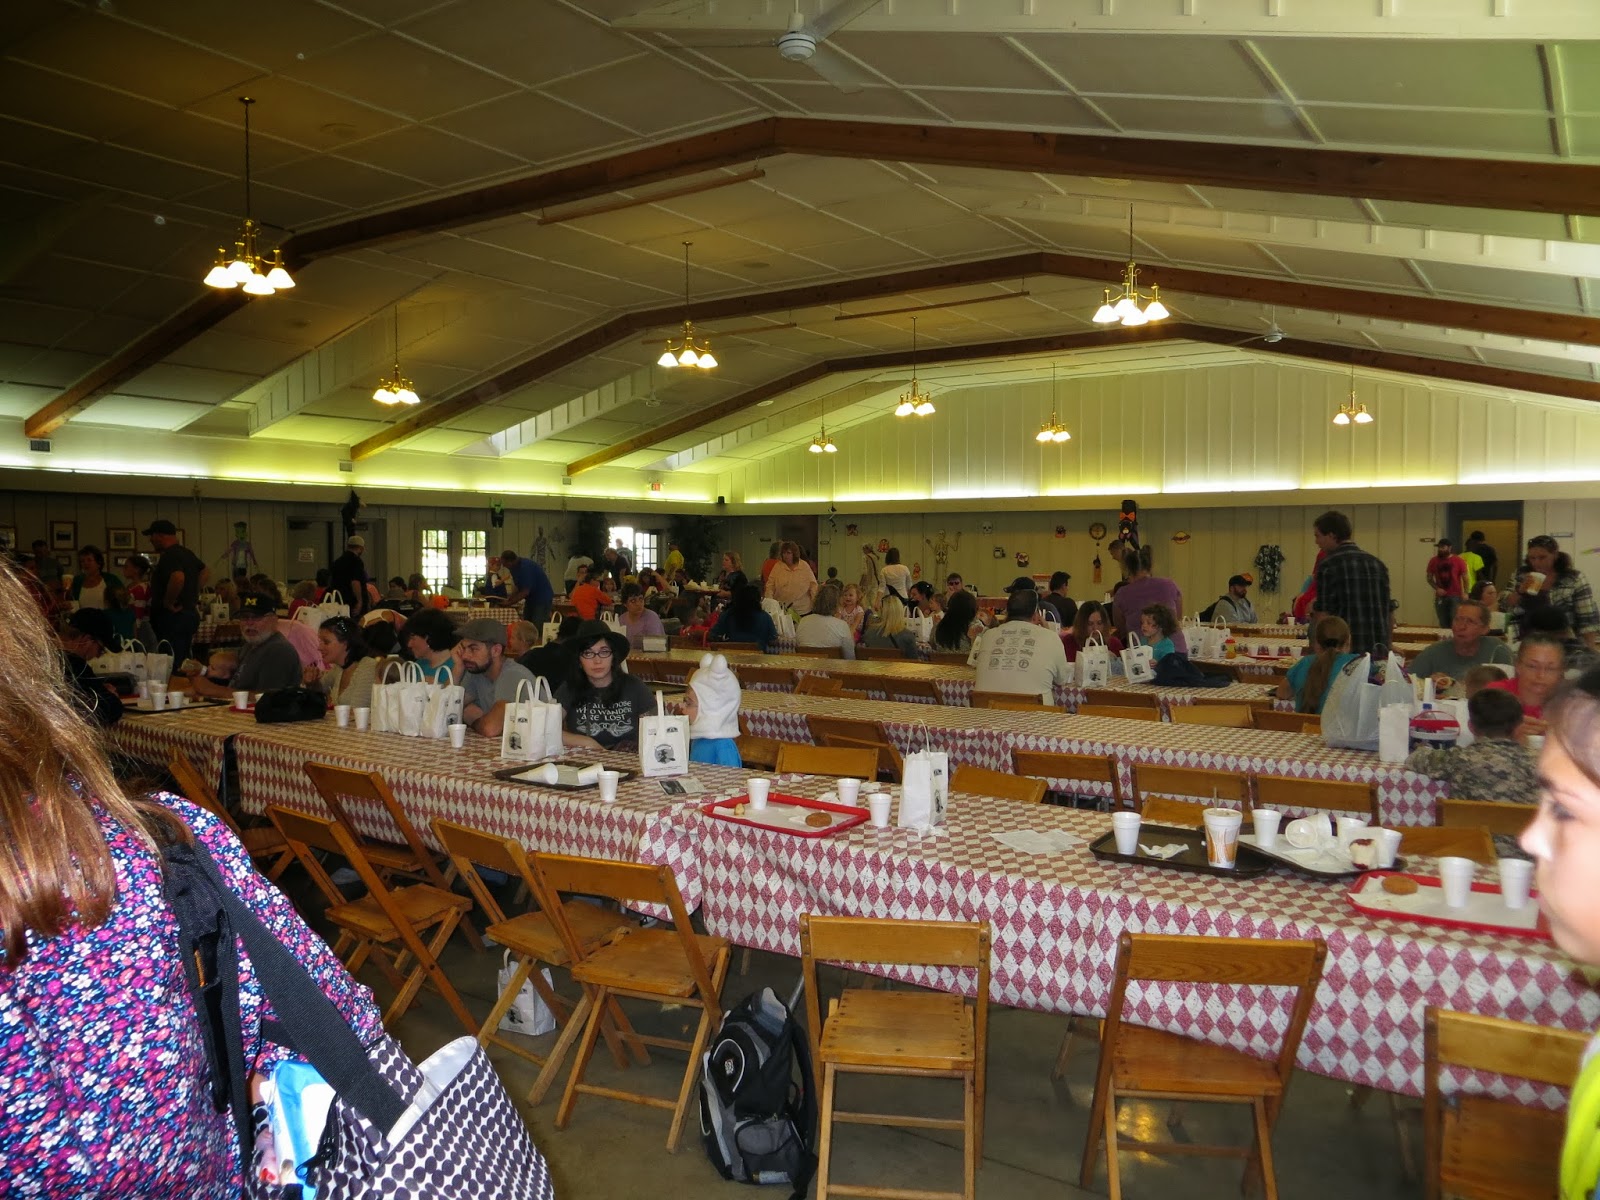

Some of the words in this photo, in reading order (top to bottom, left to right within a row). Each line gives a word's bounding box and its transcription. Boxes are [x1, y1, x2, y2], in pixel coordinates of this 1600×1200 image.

[244, 597, 257, 606] M
[597, 707, 632, 715] WANDER
[581, 713, 600, 721] ARE
[604, 713, 626, 721] LOST
